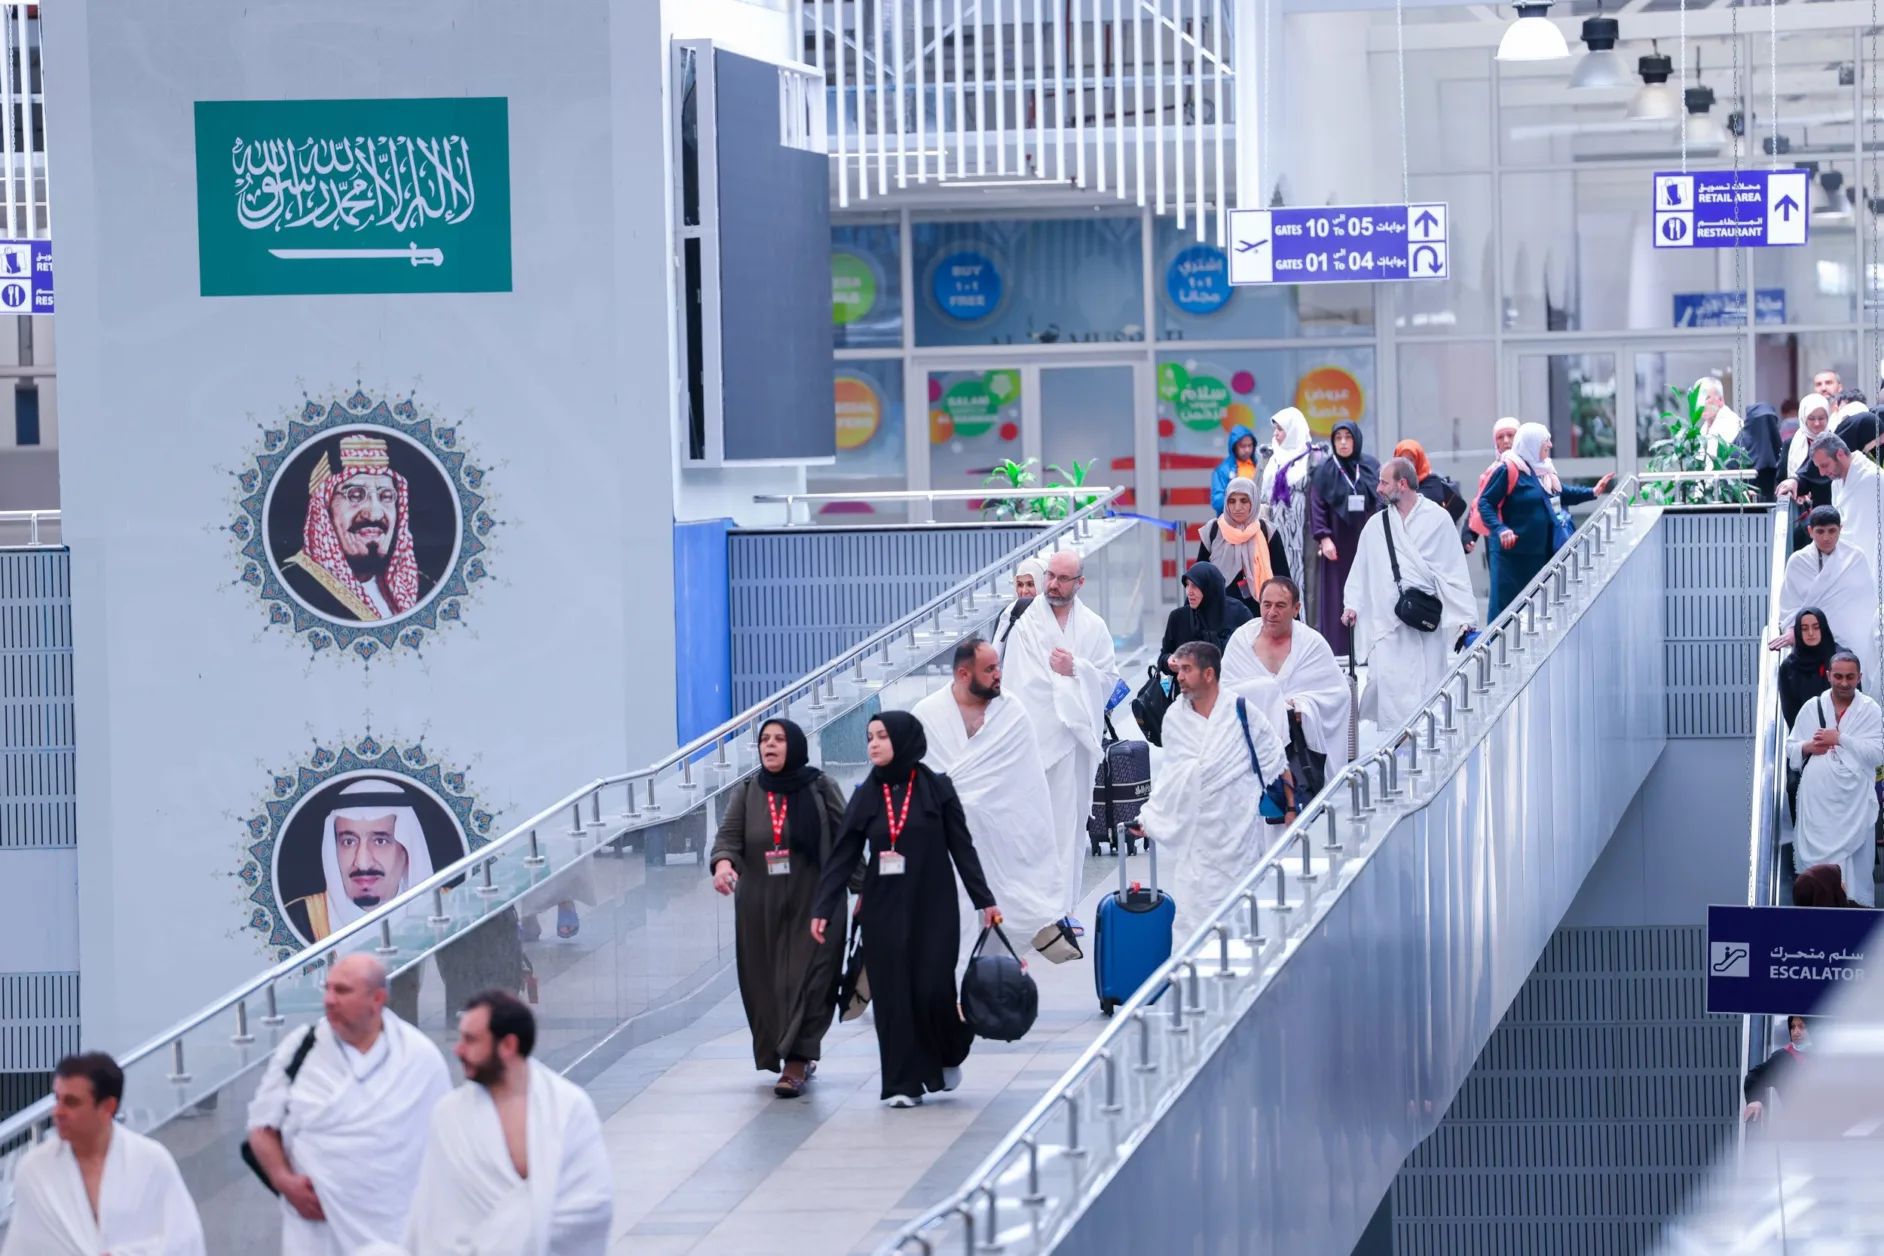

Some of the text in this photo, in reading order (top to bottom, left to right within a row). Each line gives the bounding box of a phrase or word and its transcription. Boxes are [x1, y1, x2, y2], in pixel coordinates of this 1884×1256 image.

[1698, 192, 1762, 203] RETAIL AREA
[1274, 217, 1374, 238] GATES 10 To 05
[1697, 226, 1763, 238] RESTAURANT
[1275, 251, 1375, 272] GATES 01 To 04
[952, 265, 982, 277] BUY
[949, 295, 986, 307] FREE
[1770, 946, 1864, 963] سلم متحرك
[1769, 965, 1865, 981] ESCALATOR
